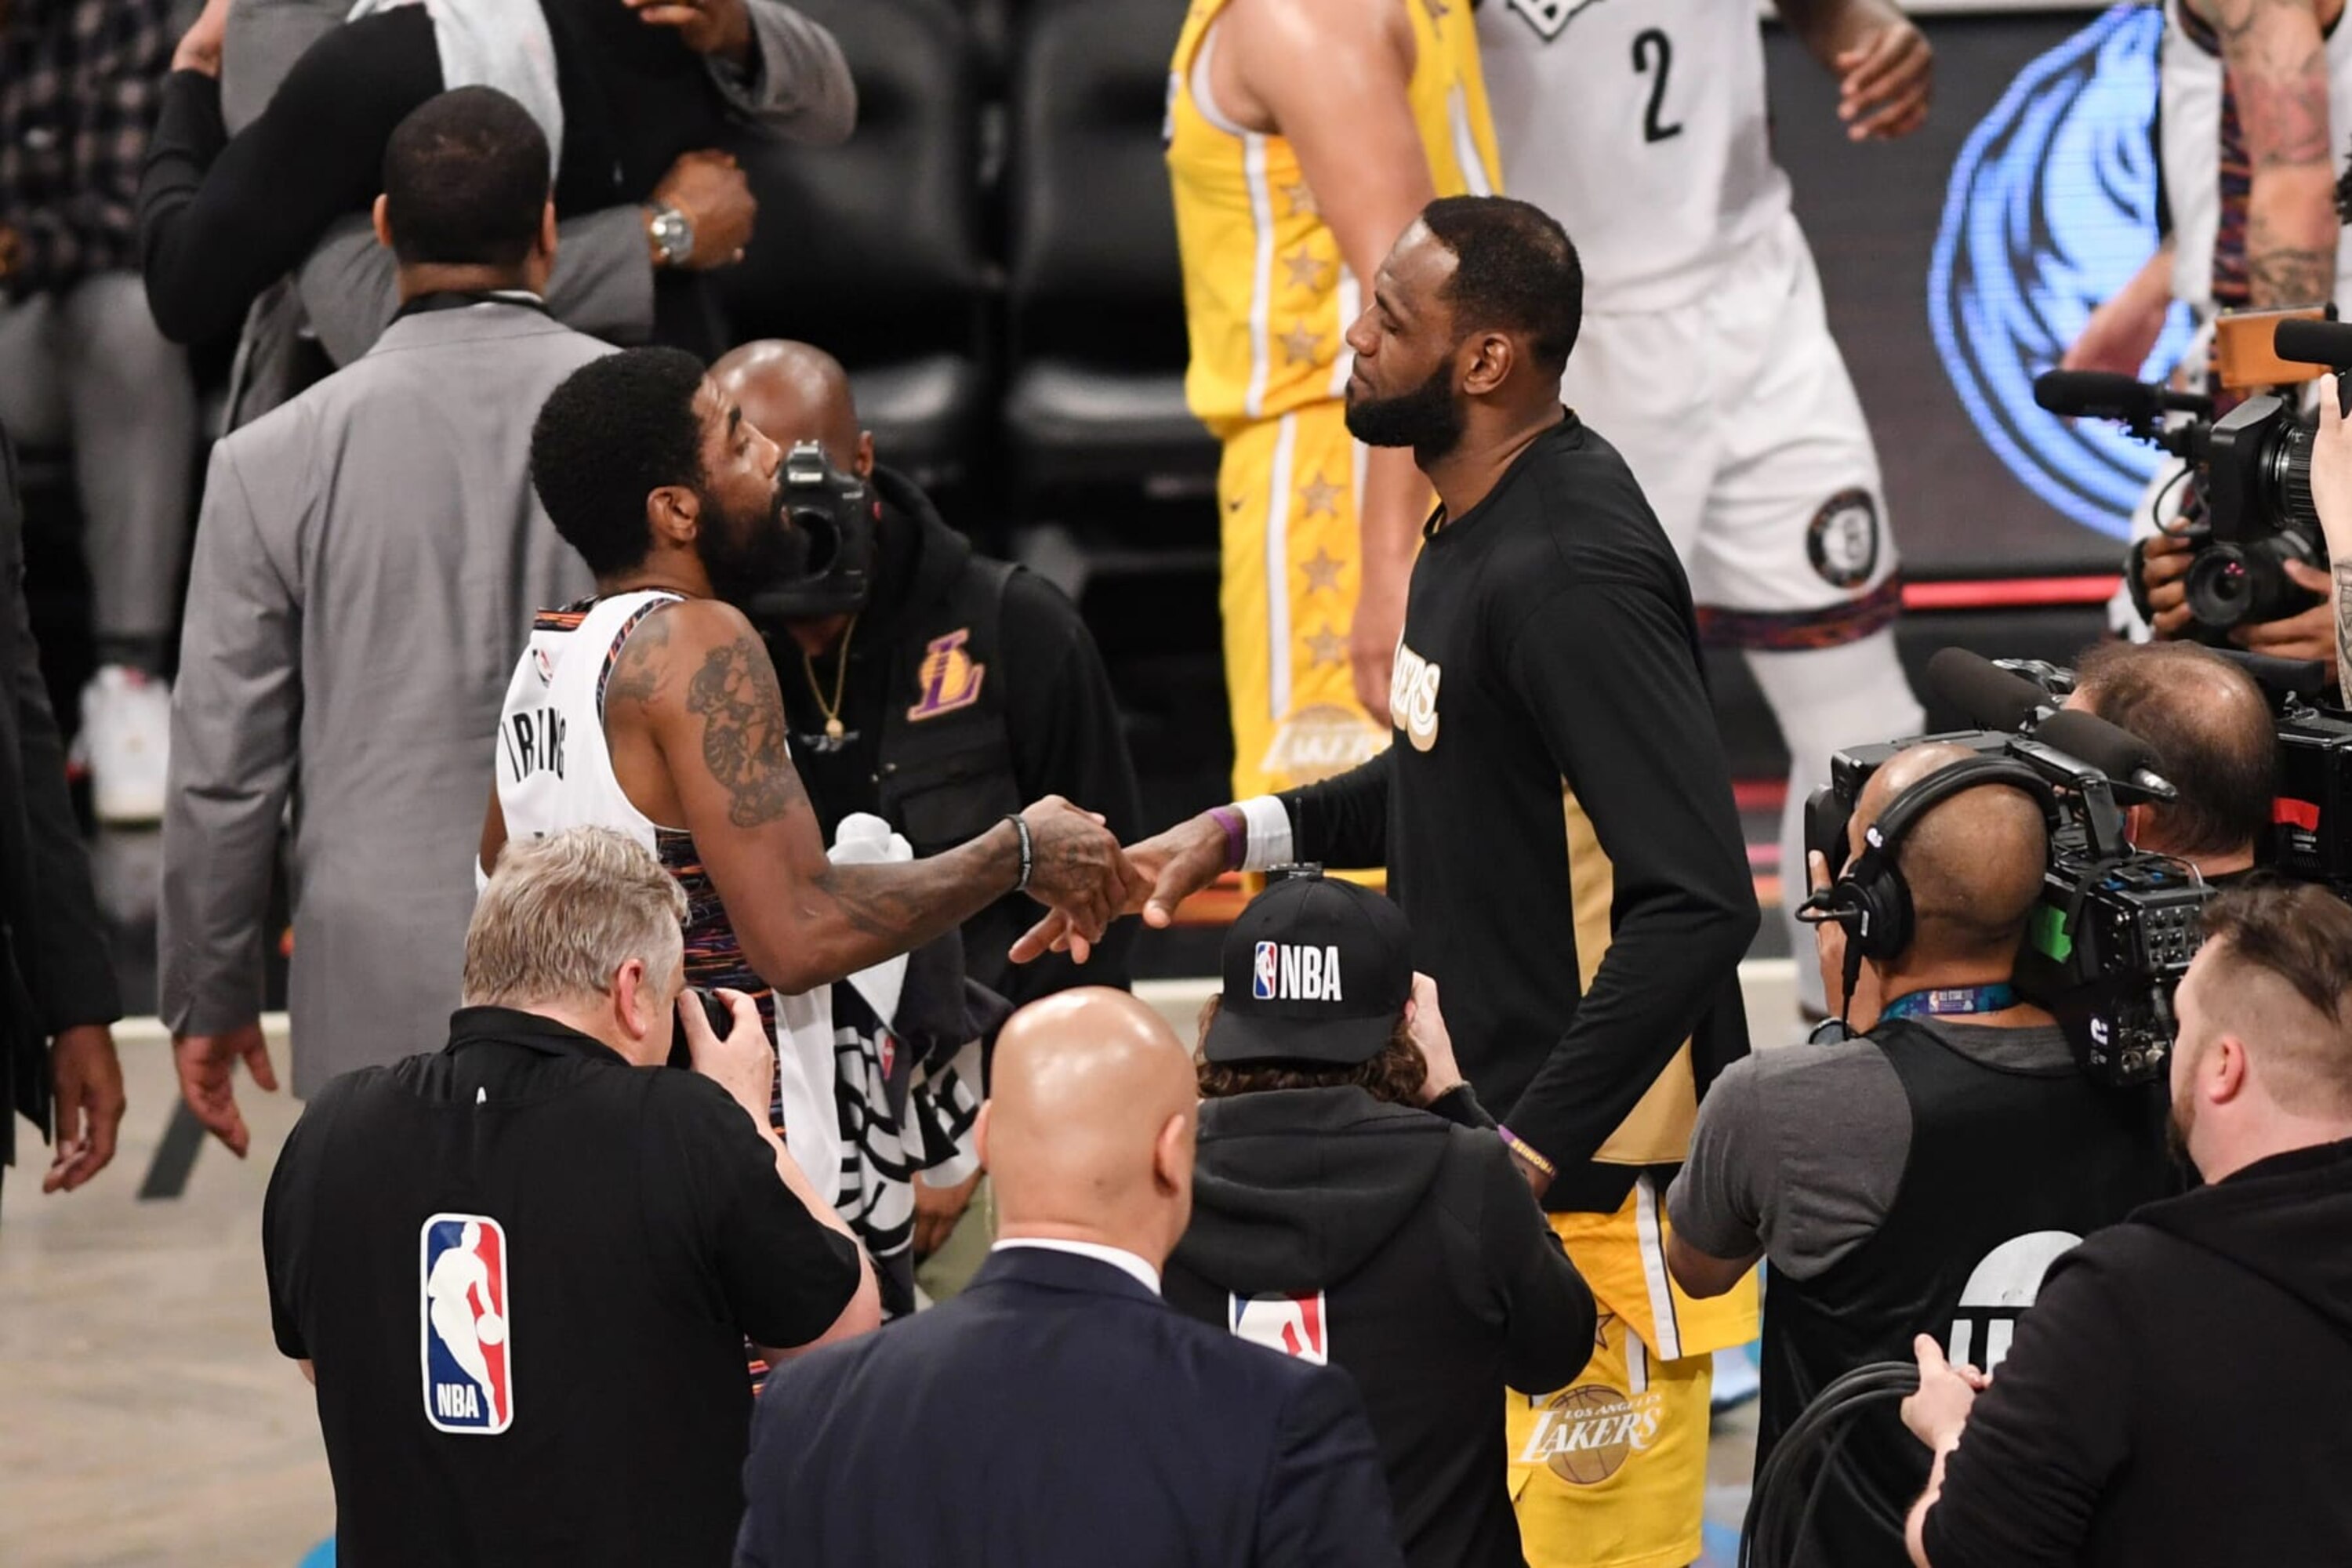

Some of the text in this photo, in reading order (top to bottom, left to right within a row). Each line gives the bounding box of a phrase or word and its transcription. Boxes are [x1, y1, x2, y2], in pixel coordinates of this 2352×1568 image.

[1632, 27, 1683, 143] 2
[1279, 944, 1343, 1001] NBA
[436, 1382, 481, 1419] NBA
[1564, 1395, 1662, 1420] LOS ANGELES
[1515, 1406, 1663, 1464] LAKERS
